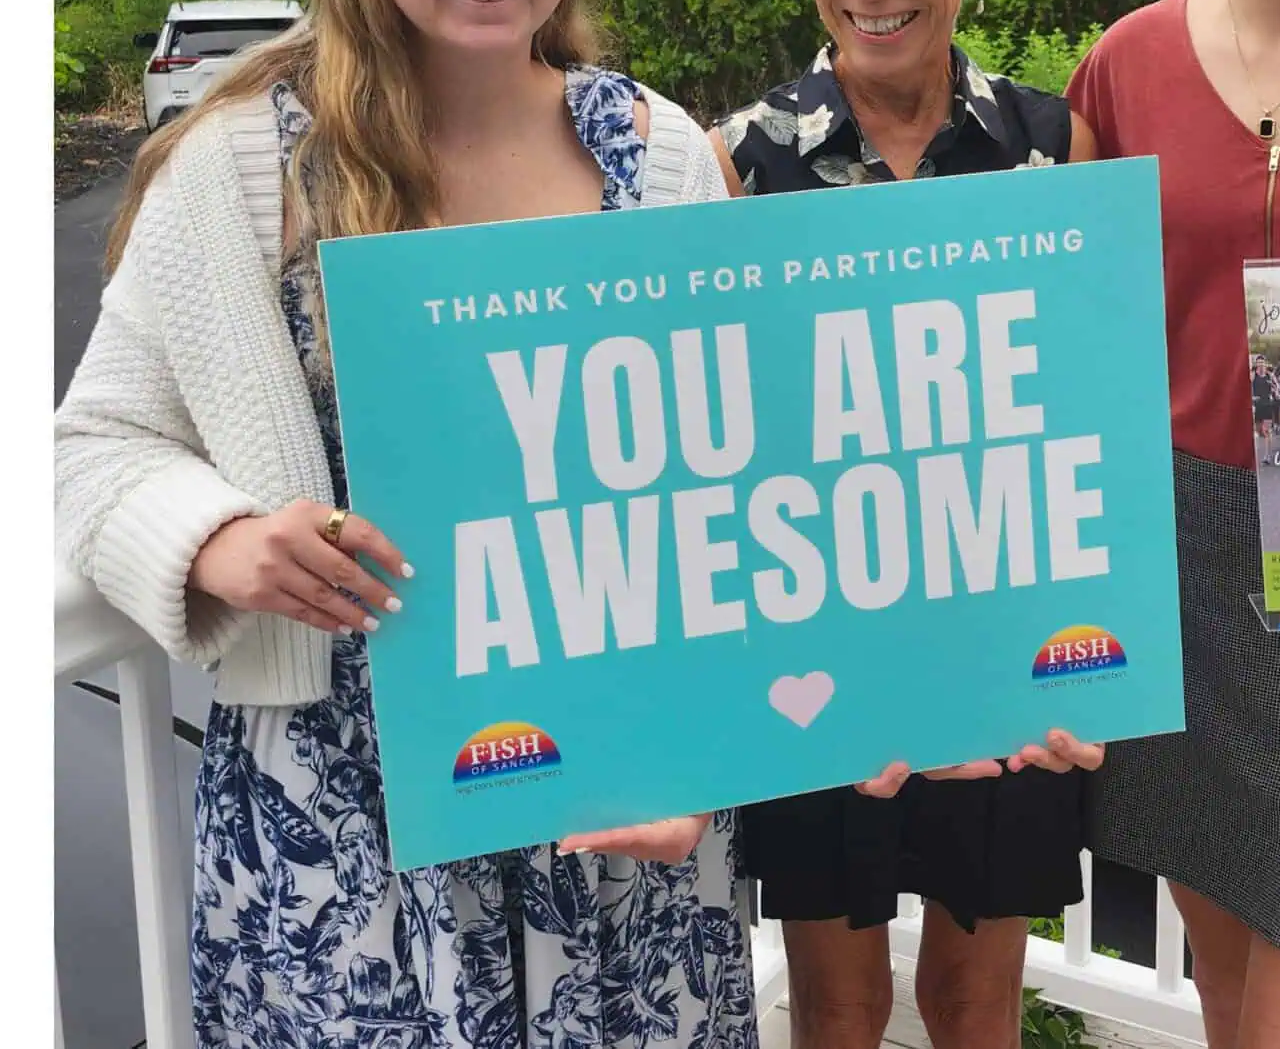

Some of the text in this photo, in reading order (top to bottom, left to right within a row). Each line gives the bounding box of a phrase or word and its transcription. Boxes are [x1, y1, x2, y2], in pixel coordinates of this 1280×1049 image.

[424, 228, 1086, 325] THANK YOU FOR PARTICIPATING
[486, 288, 1045, 504] YOU ARE
[454, 434, 1111, 678] AWESOME
[1047, 637, 1111, 664] FISH
[1047, 656, 1113, 673] OF SANCAP
[469, 733, 541, 765] FISH
[471, 755, 544, 776] OF SANCAP
